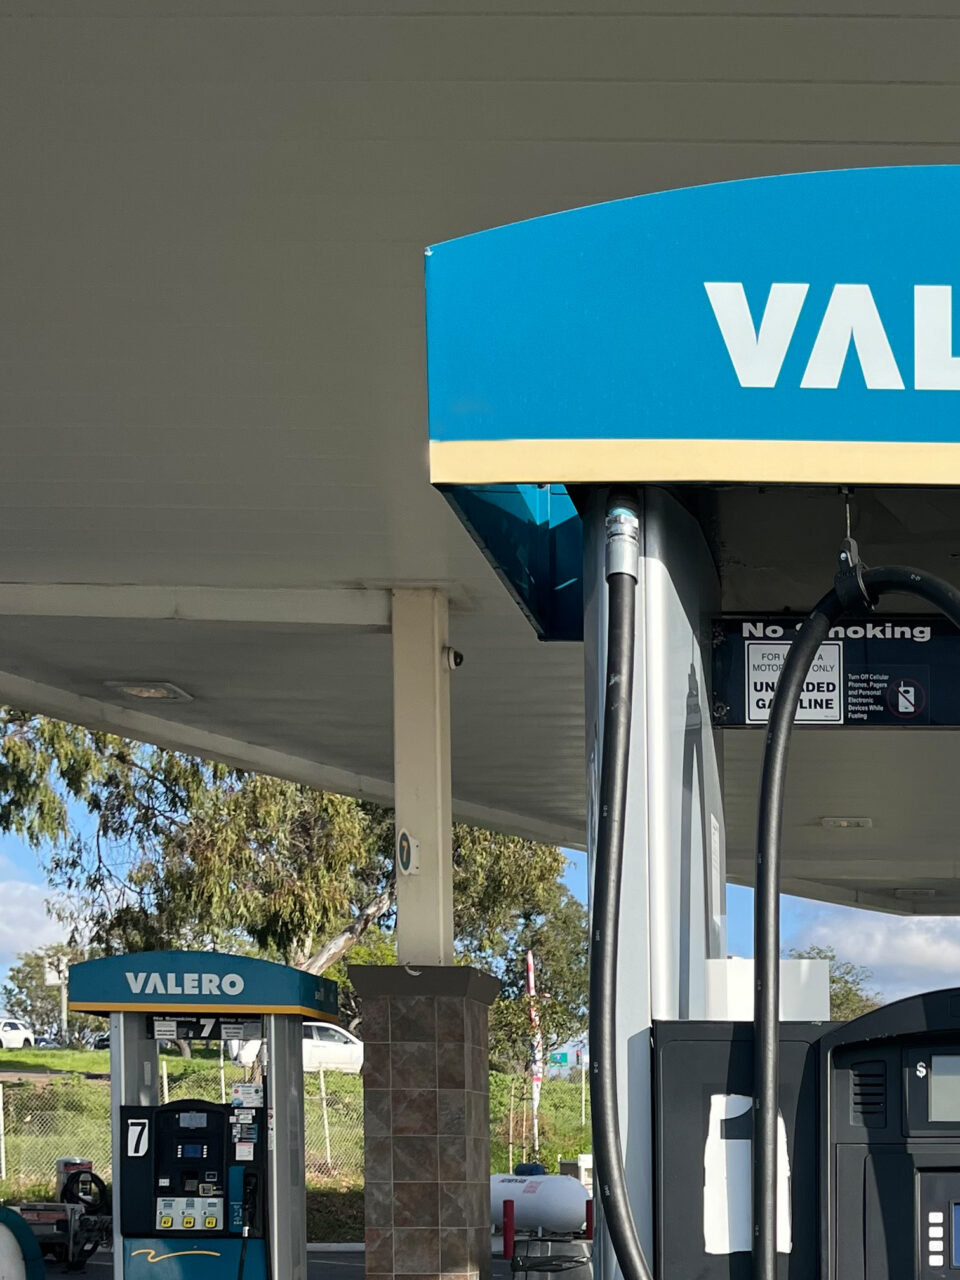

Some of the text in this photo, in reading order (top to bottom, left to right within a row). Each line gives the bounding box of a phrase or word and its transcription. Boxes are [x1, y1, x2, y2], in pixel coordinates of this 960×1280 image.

[742, 622, 784, 638] No
[761, 653, 780, 661] FOR
[812, 664, 834, 672] ONLY
[755, 699, 834, 710] GALINE
[848, 712, 867, 720] Fueling
[125, 972, 245, 996] VALERO
[200, 1018, 216, 1038] 7
[915, 1062, 927, 1078] $
[129, 1121, 147, 1155] 7
